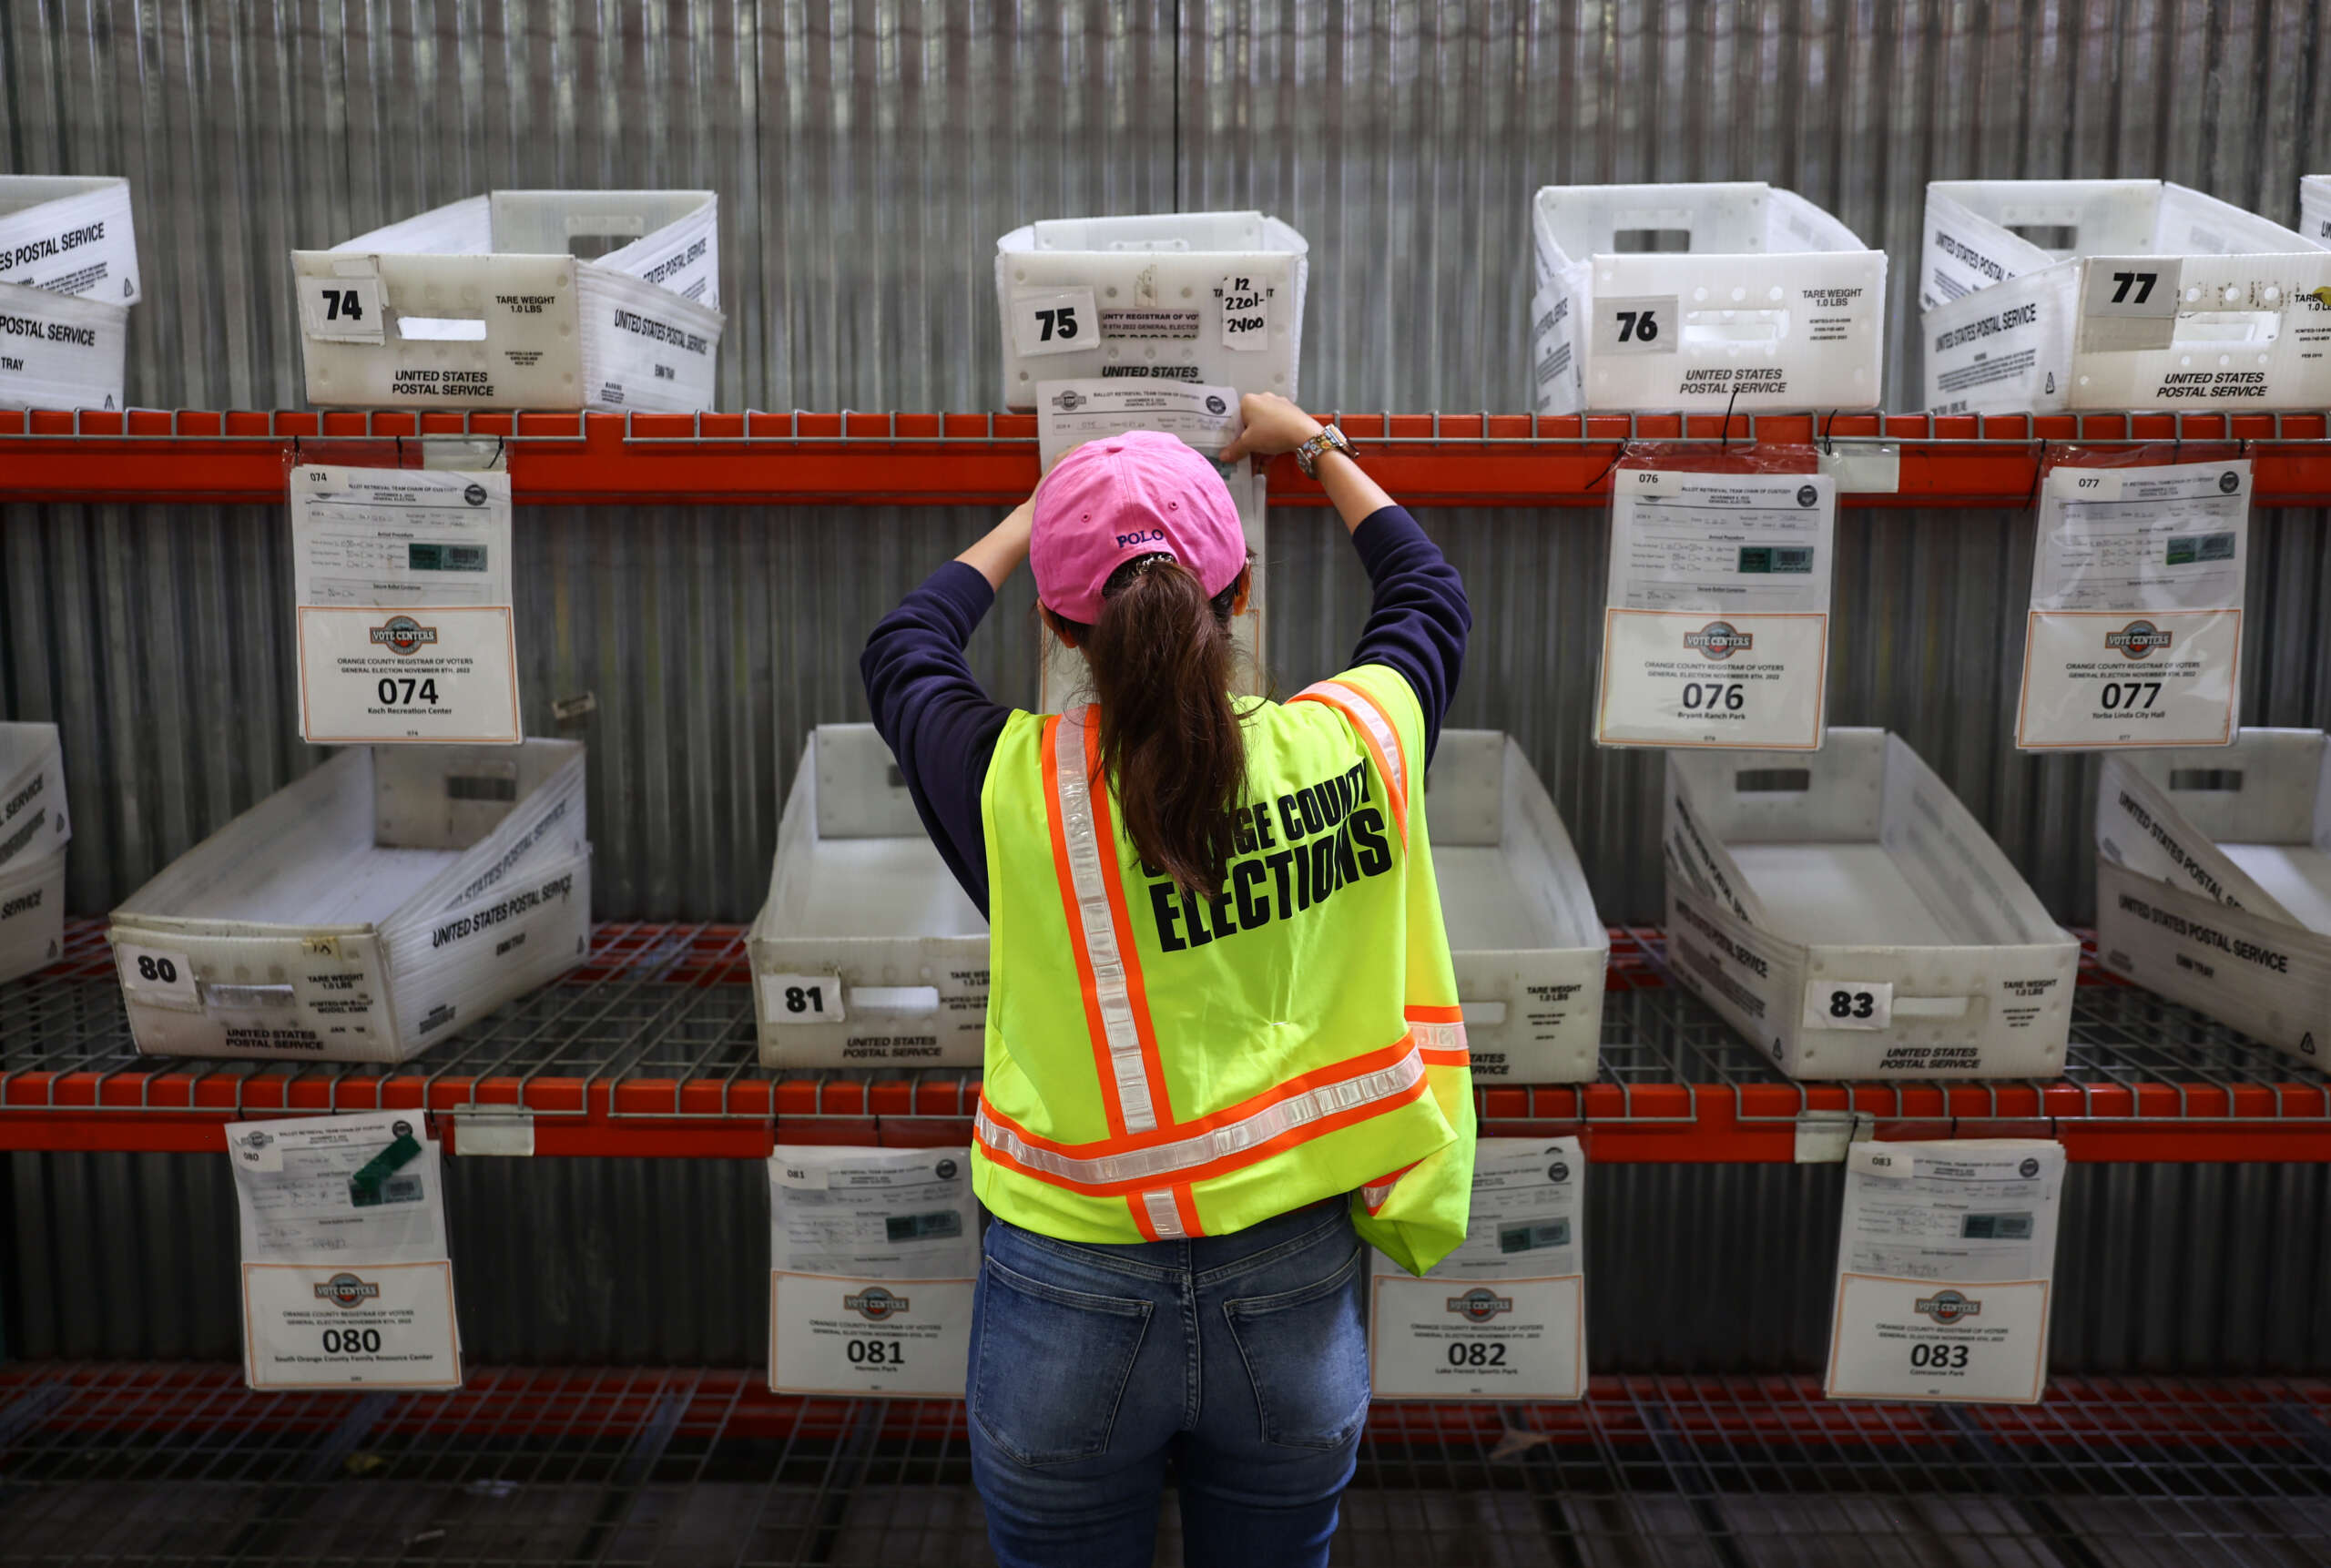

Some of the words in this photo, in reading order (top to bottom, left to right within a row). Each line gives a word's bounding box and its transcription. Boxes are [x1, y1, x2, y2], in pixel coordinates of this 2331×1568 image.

[16, 239, 59, 266] POSTAL
[62, 222, 105, 250] SERVICE
[1955, 243, 1979, 270] STATES
[666, 252, 686, 277] POSTAL
[1235, 278, 1250, 290] 12
[2111, 272, 2157, 304] 77
[496, 296, 518, 304] TARE
[521, 296, 555, 304] WEIGHT
[1803, 290, 1825, 299] TARE
[1827, 289, 1862, 298] WEIGHT
[321, 290, 362, 321] 74
[1225, 292, 1265, 311] 2201-
[1816, 299, 1827, 307] 1.0
[2307, 303, 2320, 311] 1.0
[511, 305, 522, 313] 1.0
[524, 305, 542, 313] LBS
[1035, 307, 1078, 341] 75
[1227, 317, 1264, 332] 2400
[1616, 311, 1658, 343] 76
[1977, 316, 2001, 338] POSTAL
[2002, 303, 2036, 330] SERVICE
[48, 324, 95, 347] SERVICE
[615, 309, 641, 333] UNITED
[641, 318, 666, 341] STATES
[667, 326, 685, 349] POSTAL
[687, 334, 707, 355] SERVICE
[1, 357, 24, 371] TRAY
[395, 371, 439, 382] UNITED
[443, 372, 487, 382] STATES
[1102, 366, 1149, 377] UNITED
[1151, 367, 1198, 377] STATES
[1685, 370, 1732, 380] UNITED
[1735, 369, 1783, 380] STATES
[2165, 373, 2213, 383] UNITED
[2214, 372, 2265, 383] STATES
[392, 383, 439, 394] POSTAL
[443, 385, 494, 396] SERVICE
[1680, 383, 1728, 393] POSTAL
[1732, 382, 1786, 393] SERVICE
[2157, 387, 2207, 397] POSTAL
[2210, 386, 2267, 397] SERVICE
[310, 473, 327, 482] 074
[1639, 473, 1658, 484] 076
[2078, 478, 2100, 488] 077
[1116, 529, 1164, 548] POLO
[373, 631, 395, 640] VOTE
[396, 631, 434, 641] CENTERS
[1687, 636, 1710, 646] VOTE
[1711, 636, 1749, 647] CENTERS
[378, 678, 439, 705] 074
[1683, 683, 1744, 710] 076
[2102, 683, 2162, 709] 077
[1677, 711, 1703, 719] Bryant
[5, 772, 44, 820] SERVICE
[1277, 758, 1370, 841] COUNTY
[2118, 790, 2151, 830] UNITED
[2151, 822, 2183, 864] STATES
[2183, 857, 2223, 903] POSTAL
[1148, 808, 1392, 952] ELECTIONS
[432, 918, 472, 949] UNITED
[473, 903, 508, 932] STATES
[509, 890, 540, 915] POSTAL
[2187, 921, 2232, 952] POSTAL
[2233, 940, 2289, 973] SERVICE
[137, 955, 177, 983] 80
[1735, 945, 1768, 980] SERVICE
[331, 973, 363, 983] WEIGHT
[2026, 979, 2057, 988] WEIGHT
[1527, 986, 1548, 994] TARE
[1550, 984, 1582, 993] WEIGHT
[785, 986, 824, 1013] 81
[1552, 993, 1569, 1001] LBS
[1829, 991, 1874, 1019] 83
[227, 1030, 270, 1039] UNITED
[272, 1030, 317, 1040] STATES
[847, 1037, 891, 1046] UNITED
[892, 1036, 937, 1045] STATES
[226, 1039, 270, 1048] POSTAL
[274, 1040, 324, 1050] SERVICE
[843, 1048, 889, 1058] POSTAL
[892, 1047, 942, 1057] SERVICE
[1887, 1049, 1931, 1058] UNITED
[1932, 1048, 1978, 1057] STATES
[1879, 1060, 1927, 1069] POSTAL
[1929, 1059, 1981, 1069] SERVICE
[1872, 1157, 1891, 1166] 083
[787, 1169, 805, 1179] 081
[322, 1329, 381, 1353] 080
[847, 1339, 905, 1364] 081
[1448, 1342, 1506, 1366] 082
[1911, 1344, 1970, 1369] 083
